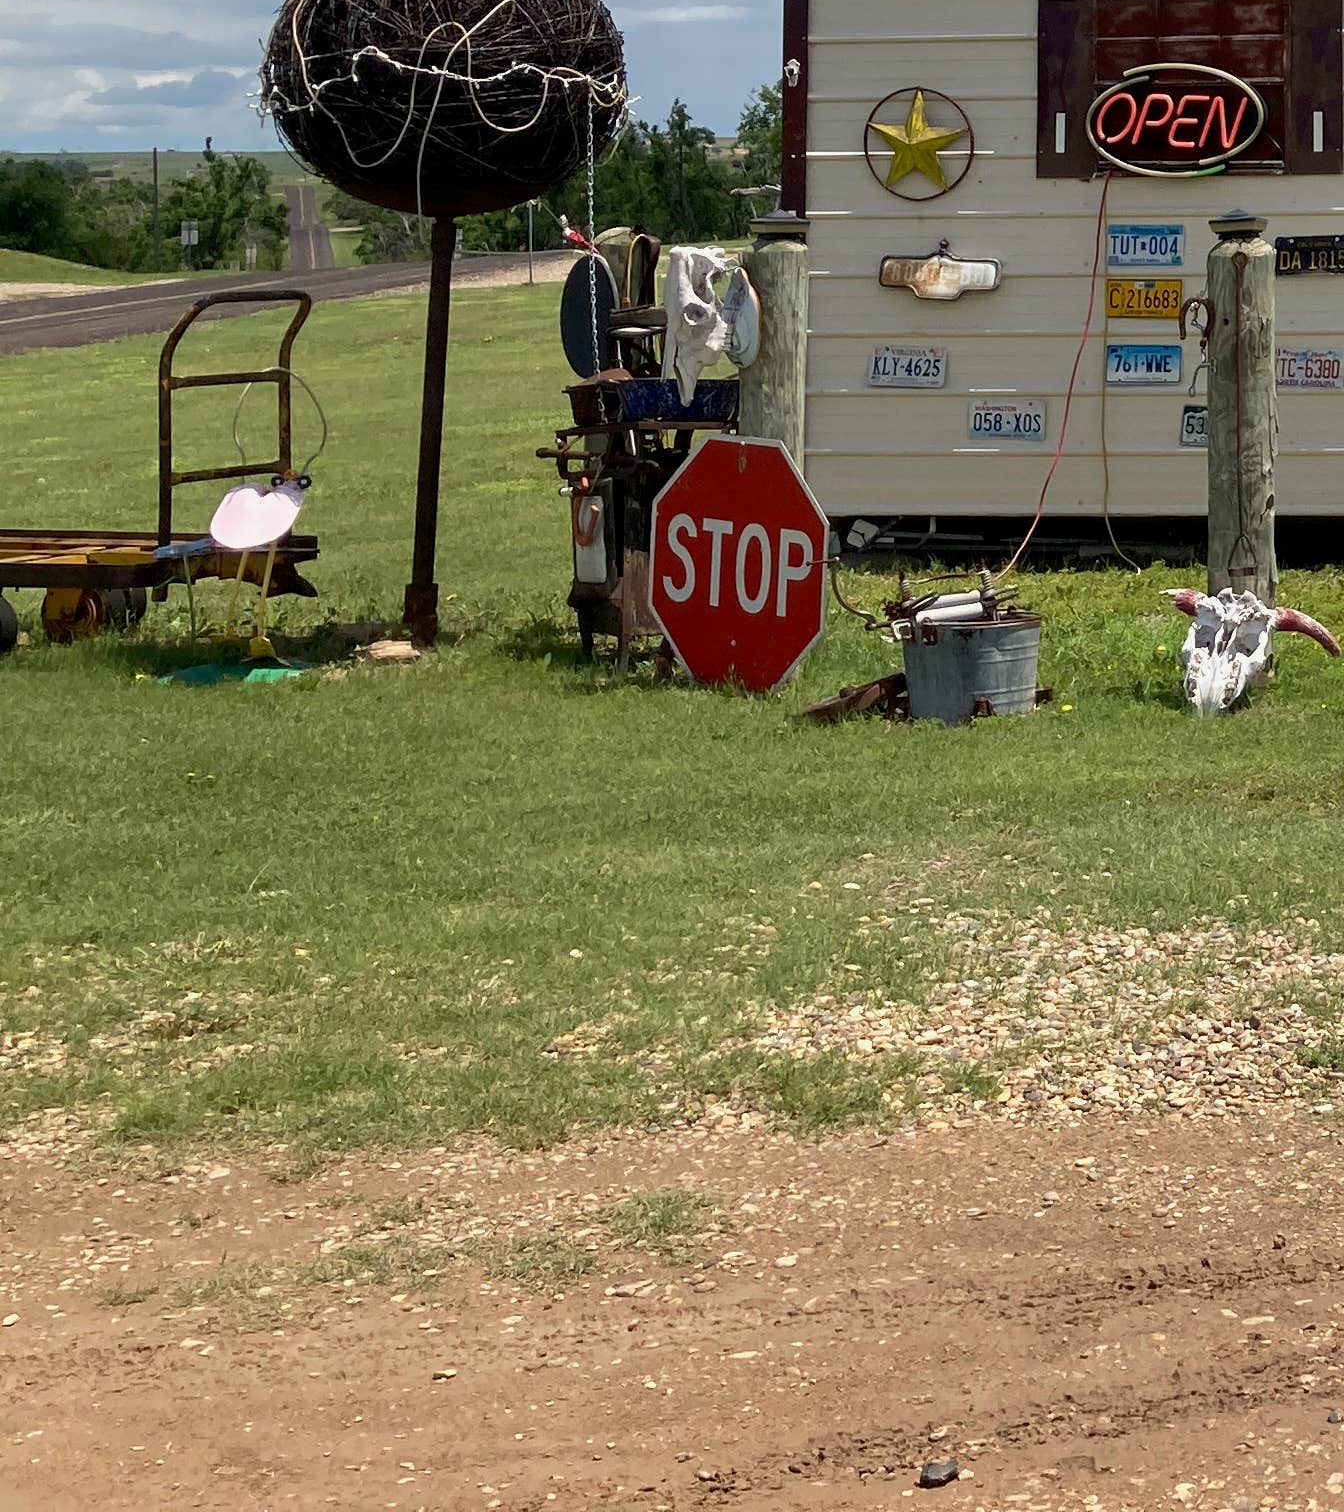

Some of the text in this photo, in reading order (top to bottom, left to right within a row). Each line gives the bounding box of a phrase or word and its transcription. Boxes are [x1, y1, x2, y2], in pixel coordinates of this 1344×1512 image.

[1096, 92, 1249, 149] OPEN
[872, 356, 942, 377] KLY-4625
[1277, 358, 1340, 379] TC-6380
[662, 512, 814, 618] STOP
